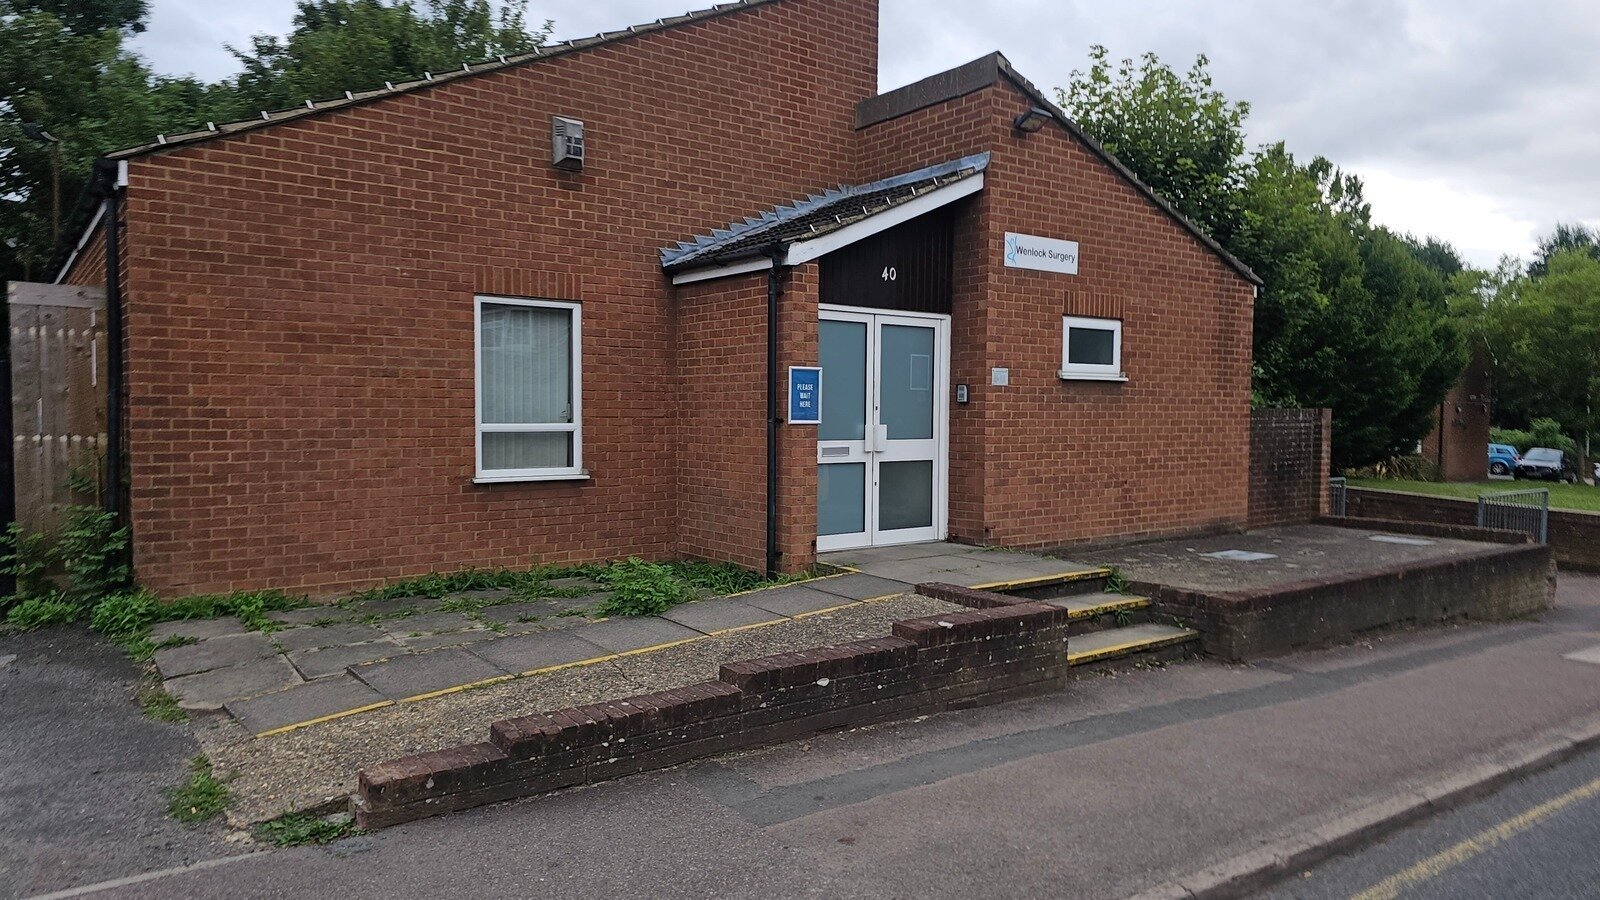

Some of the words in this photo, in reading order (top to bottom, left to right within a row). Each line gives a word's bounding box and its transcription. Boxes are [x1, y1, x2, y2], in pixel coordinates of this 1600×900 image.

[1016, 245, 1047, 258] Wenlock
[1048, 250, 1075, 263] Surgery
[881, 266, 897, 281] 40
